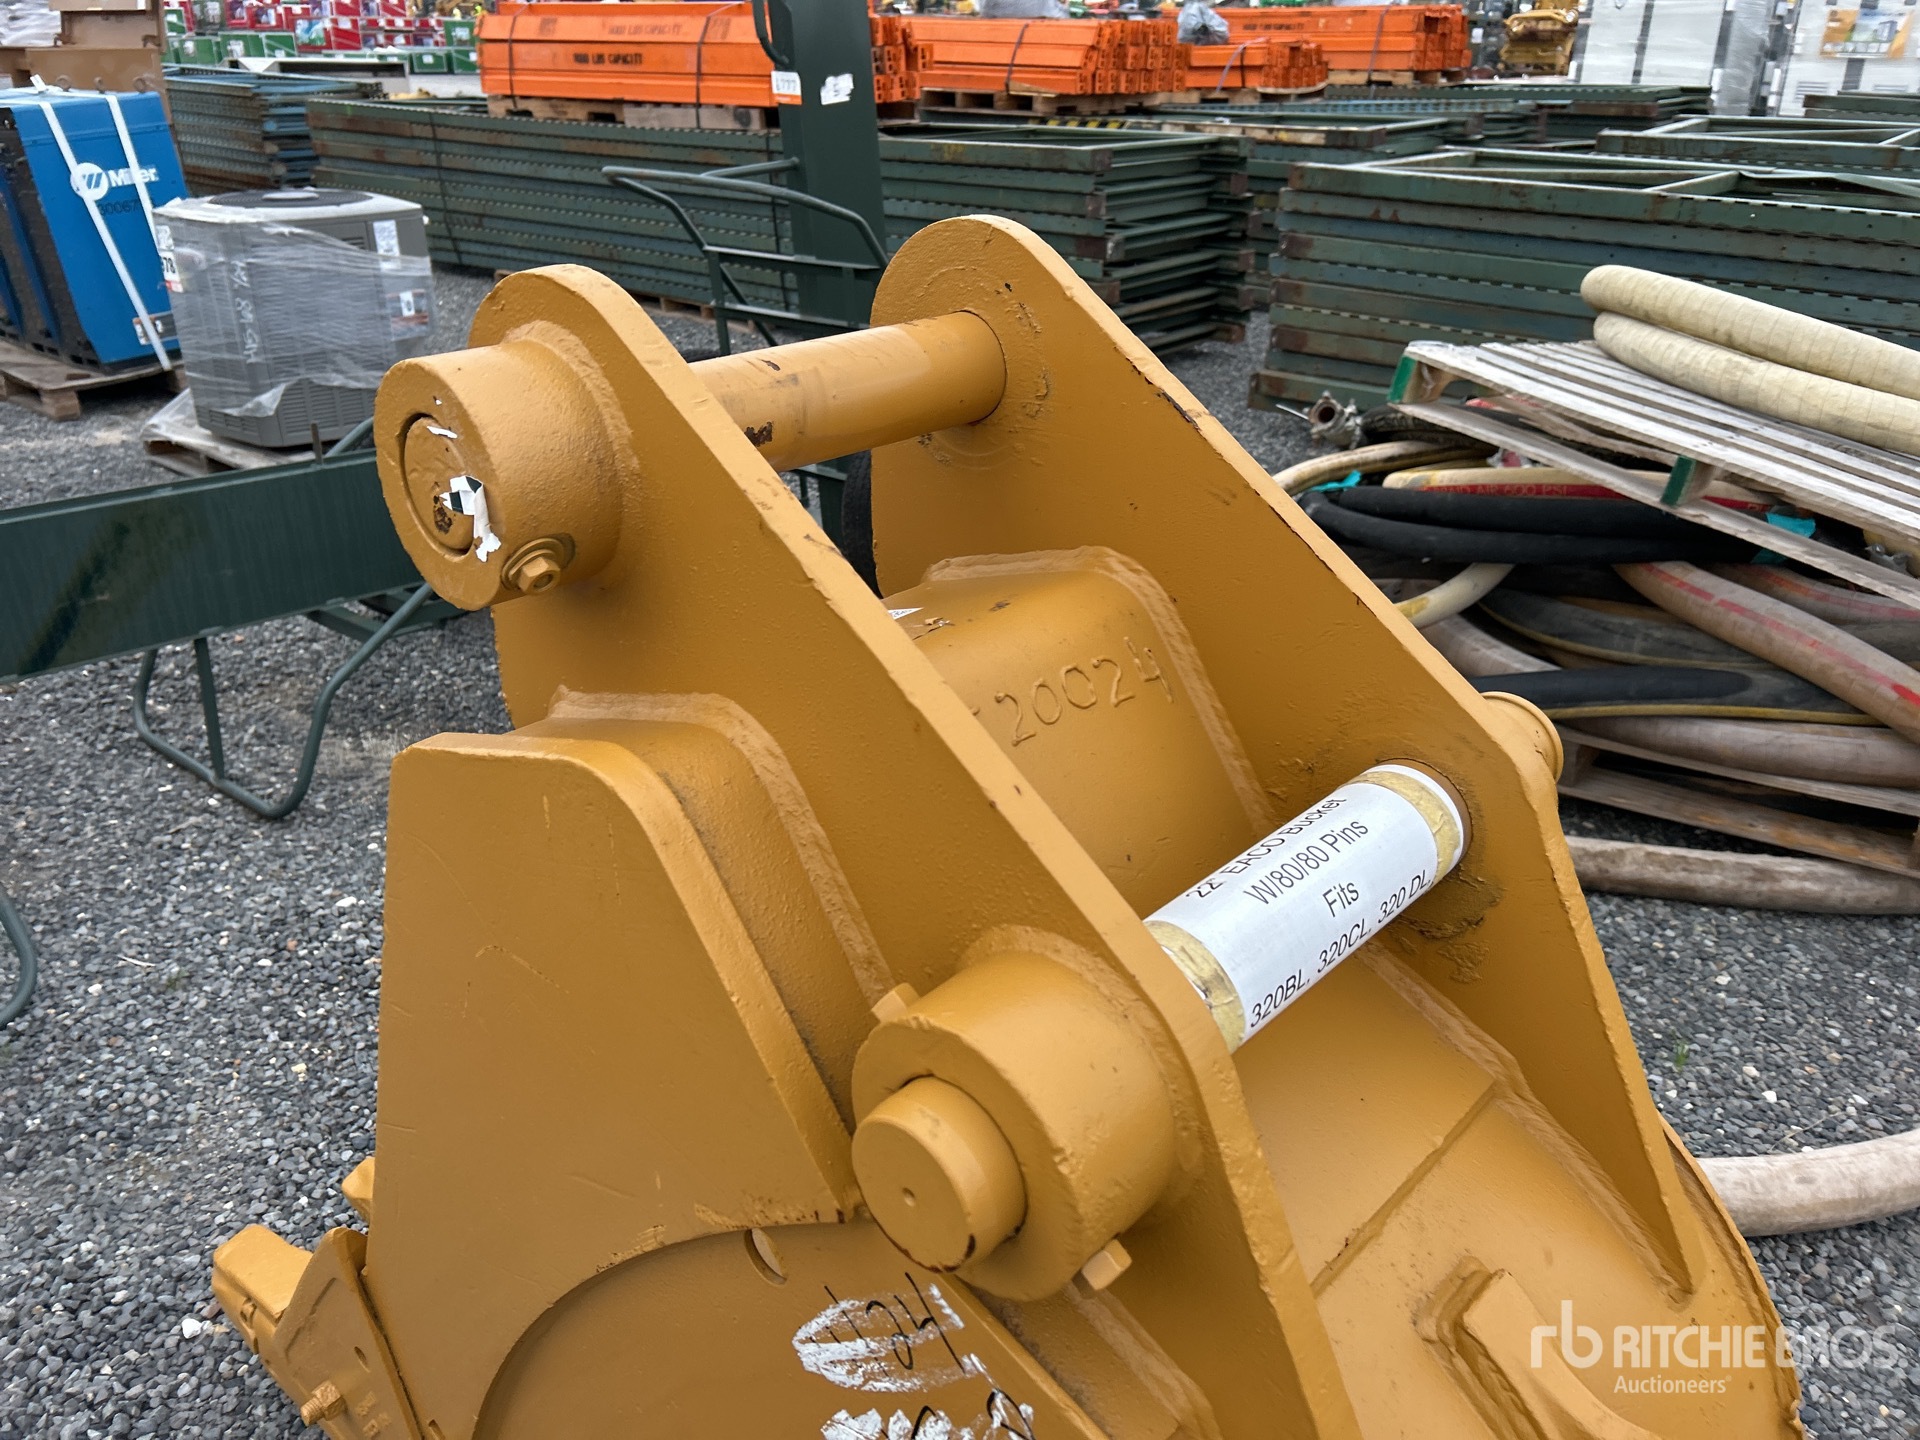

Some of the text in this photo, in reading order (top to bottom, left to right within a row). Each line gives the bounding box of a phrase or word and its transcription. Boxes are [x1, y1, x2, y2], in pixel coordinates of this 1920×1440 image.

[107, 168, 159, 187] Mier
[1277, 798, 1347, 836] Bucket
[1243, 820, 1369, 905] W/80/80 Pins
[1322, 881, 1360, 918] Fits
[1378, 886, 1407, 924] 320
